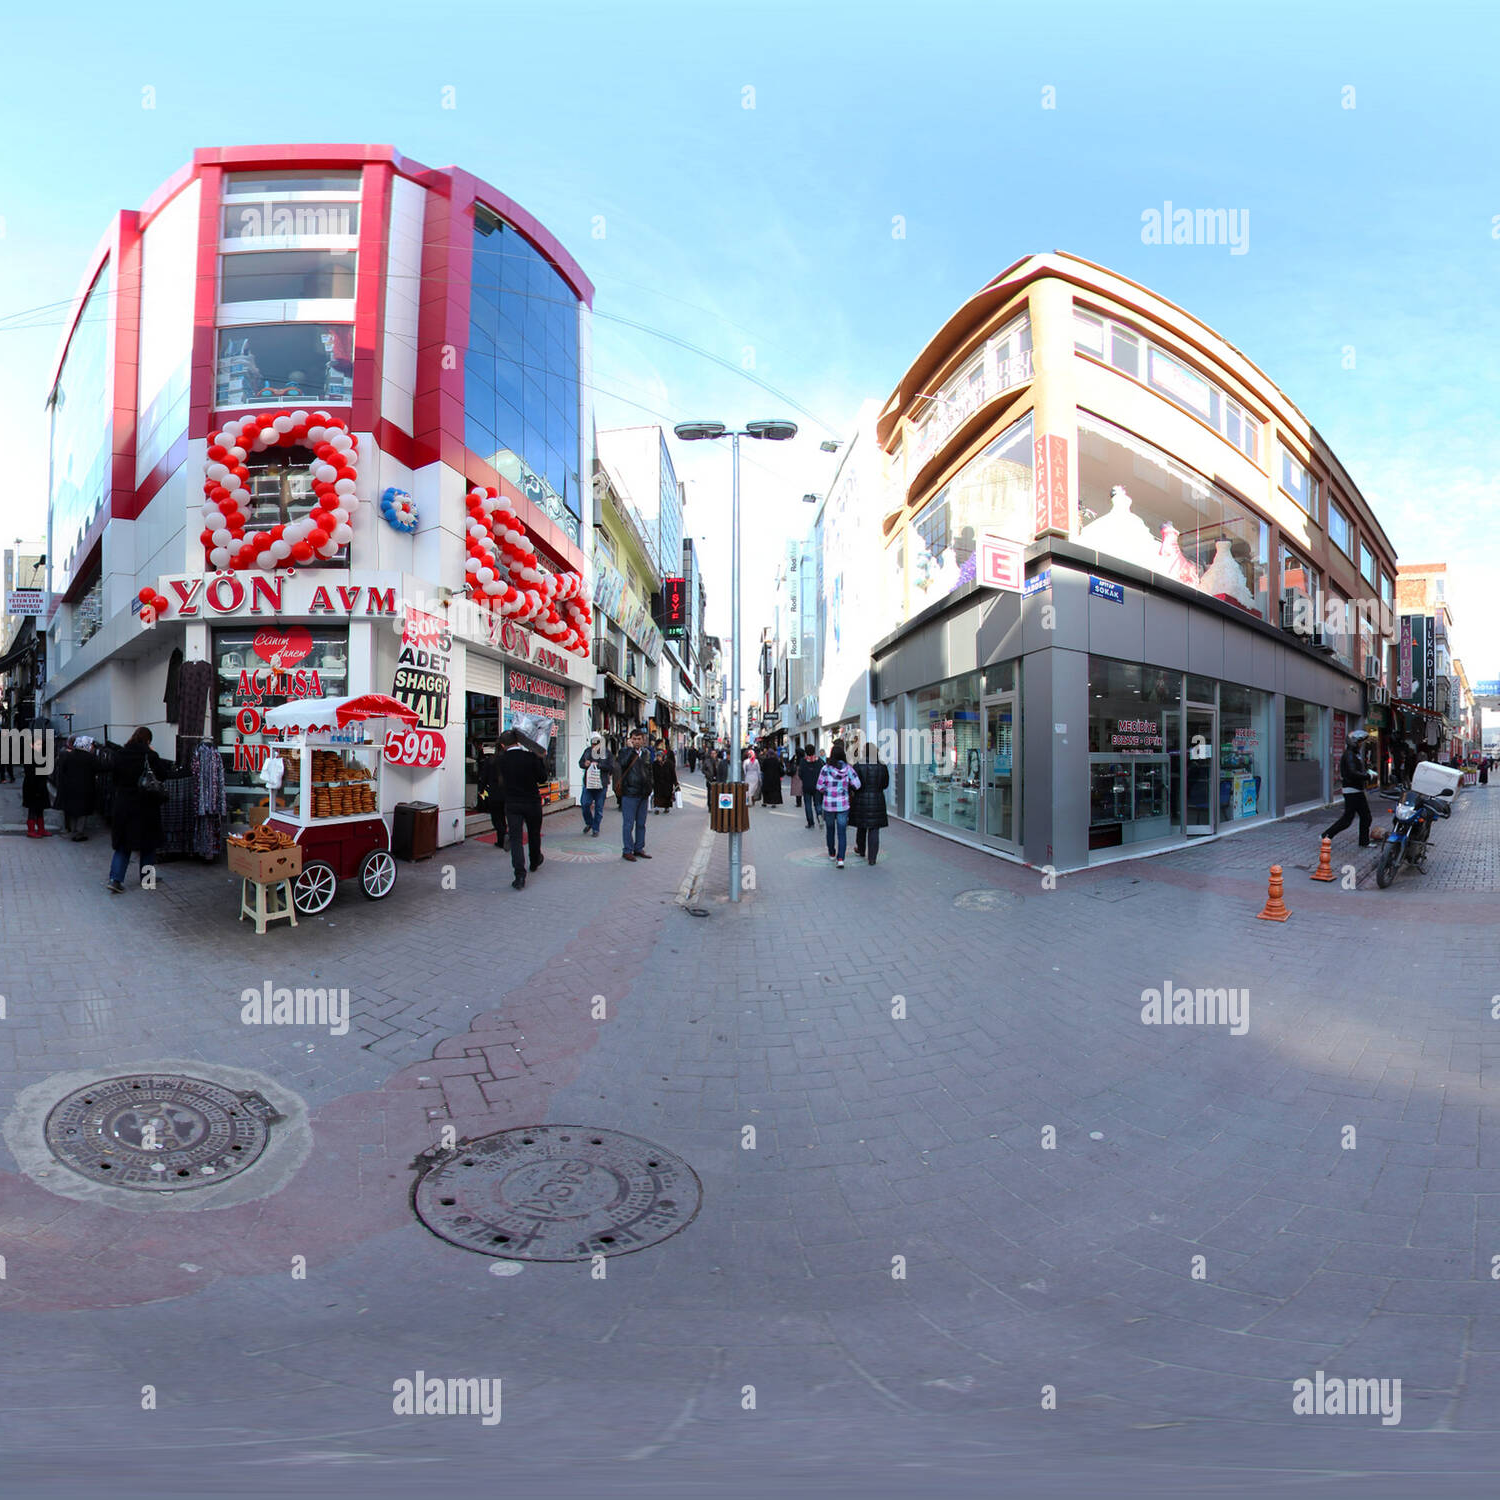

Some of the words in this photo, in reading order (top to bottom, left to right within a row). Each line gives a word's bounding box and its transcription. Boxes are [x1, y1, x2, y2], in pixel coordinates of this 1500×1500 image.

[992, 553, 1011, 581] E
[168, 569, 284, 616] YÖN
[308, 586, 398, 615] AVM
[1094, 585, 1119, 599] SOKAK
[399, 648, 450, 673] ADET
[534, 647, 569, 676] AVM
[396, 671, 449, 694] SHAGGY
[1118, 719, 1157, 734] MECİDİYE
